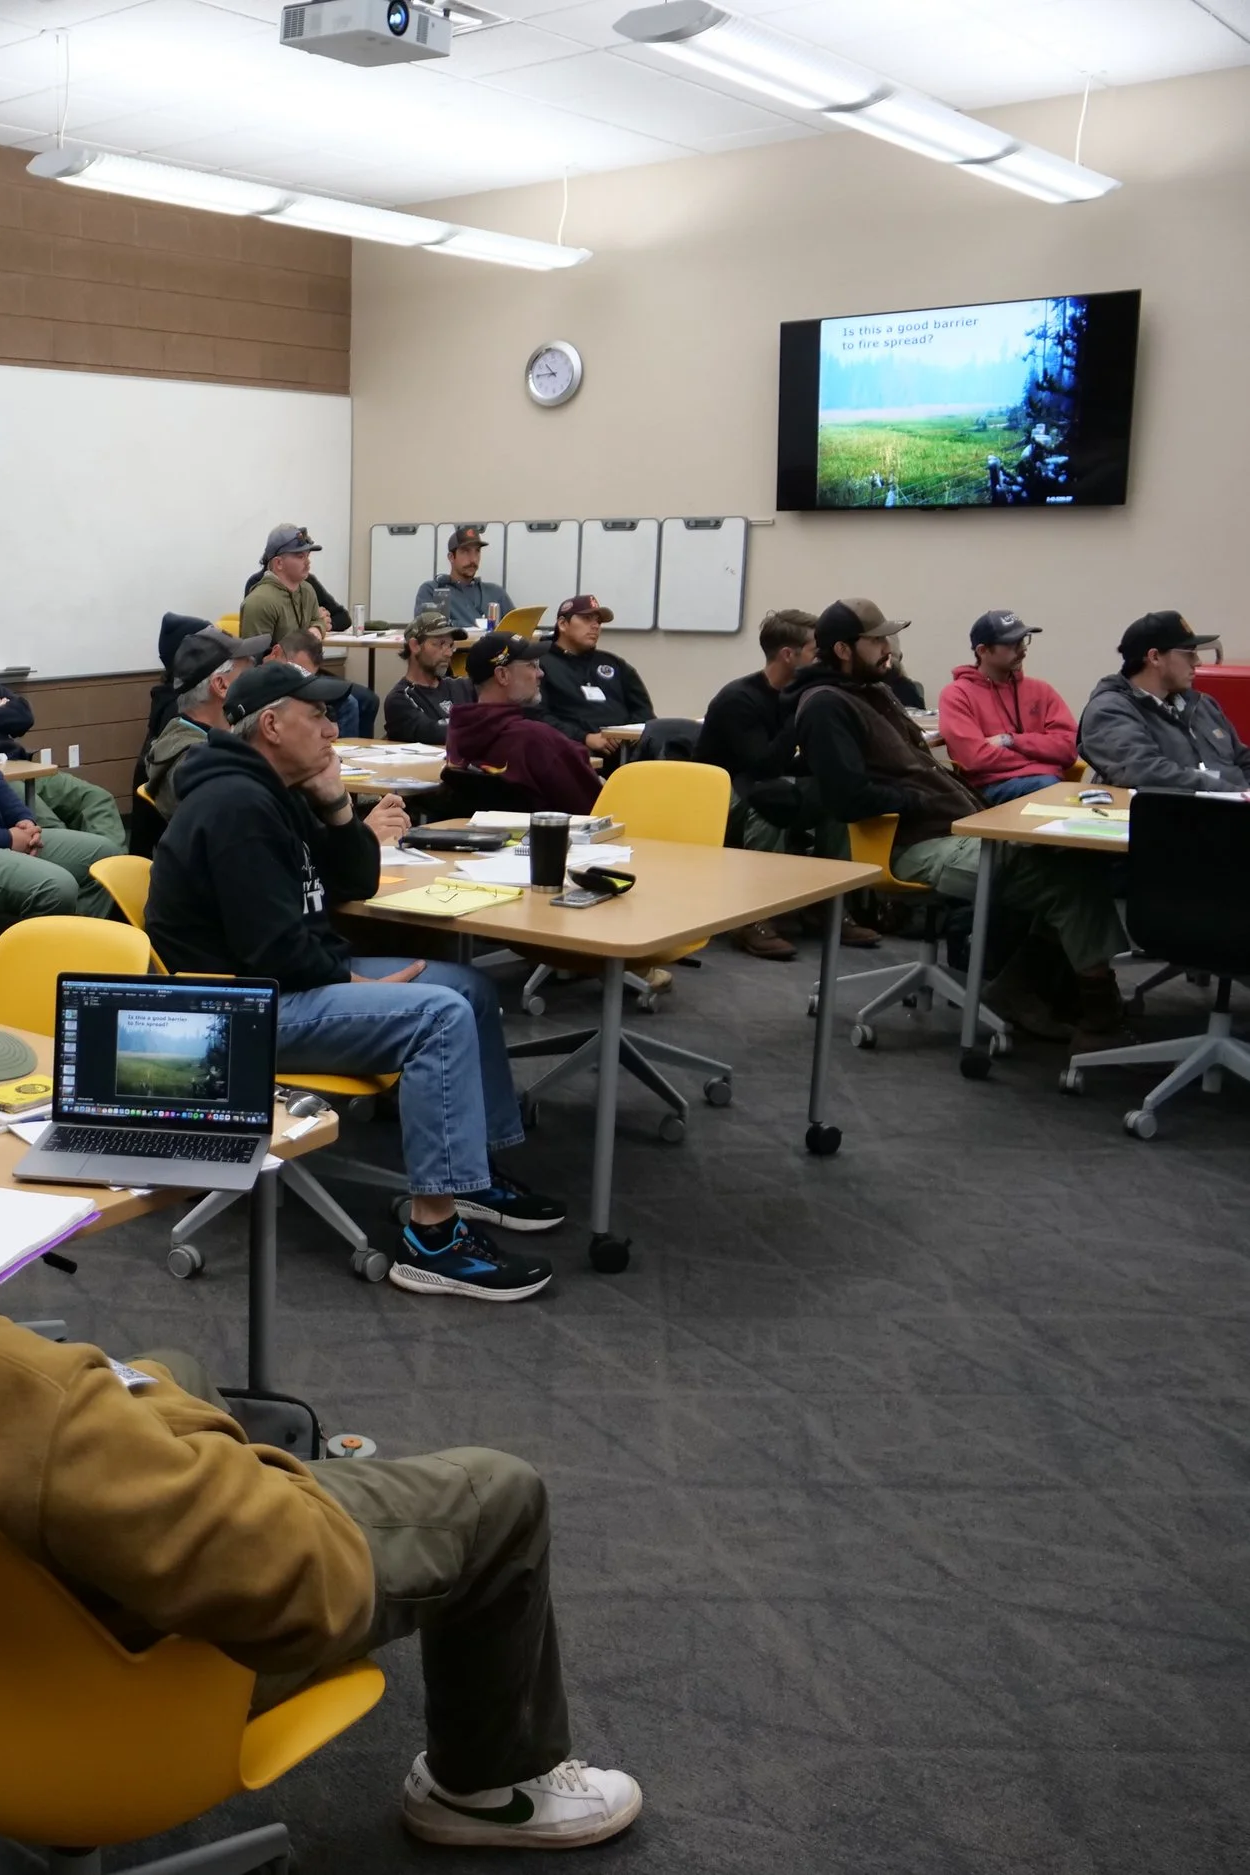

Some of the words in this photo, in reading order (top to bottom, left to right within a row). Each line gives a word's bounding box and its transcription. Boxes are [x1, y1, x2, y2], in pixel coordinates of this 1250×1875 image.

[843, 327, 855, 337] Is
[859, 325, 882, 336] this
[886, 326, 893, 334] a
[898, 320, 928, 334] good
[933, 317, 979, 329] barrier
[842, 341, 854, 351] to
[858, 339, 879, 349] fire
[883, 333, 934, 348] spread?
